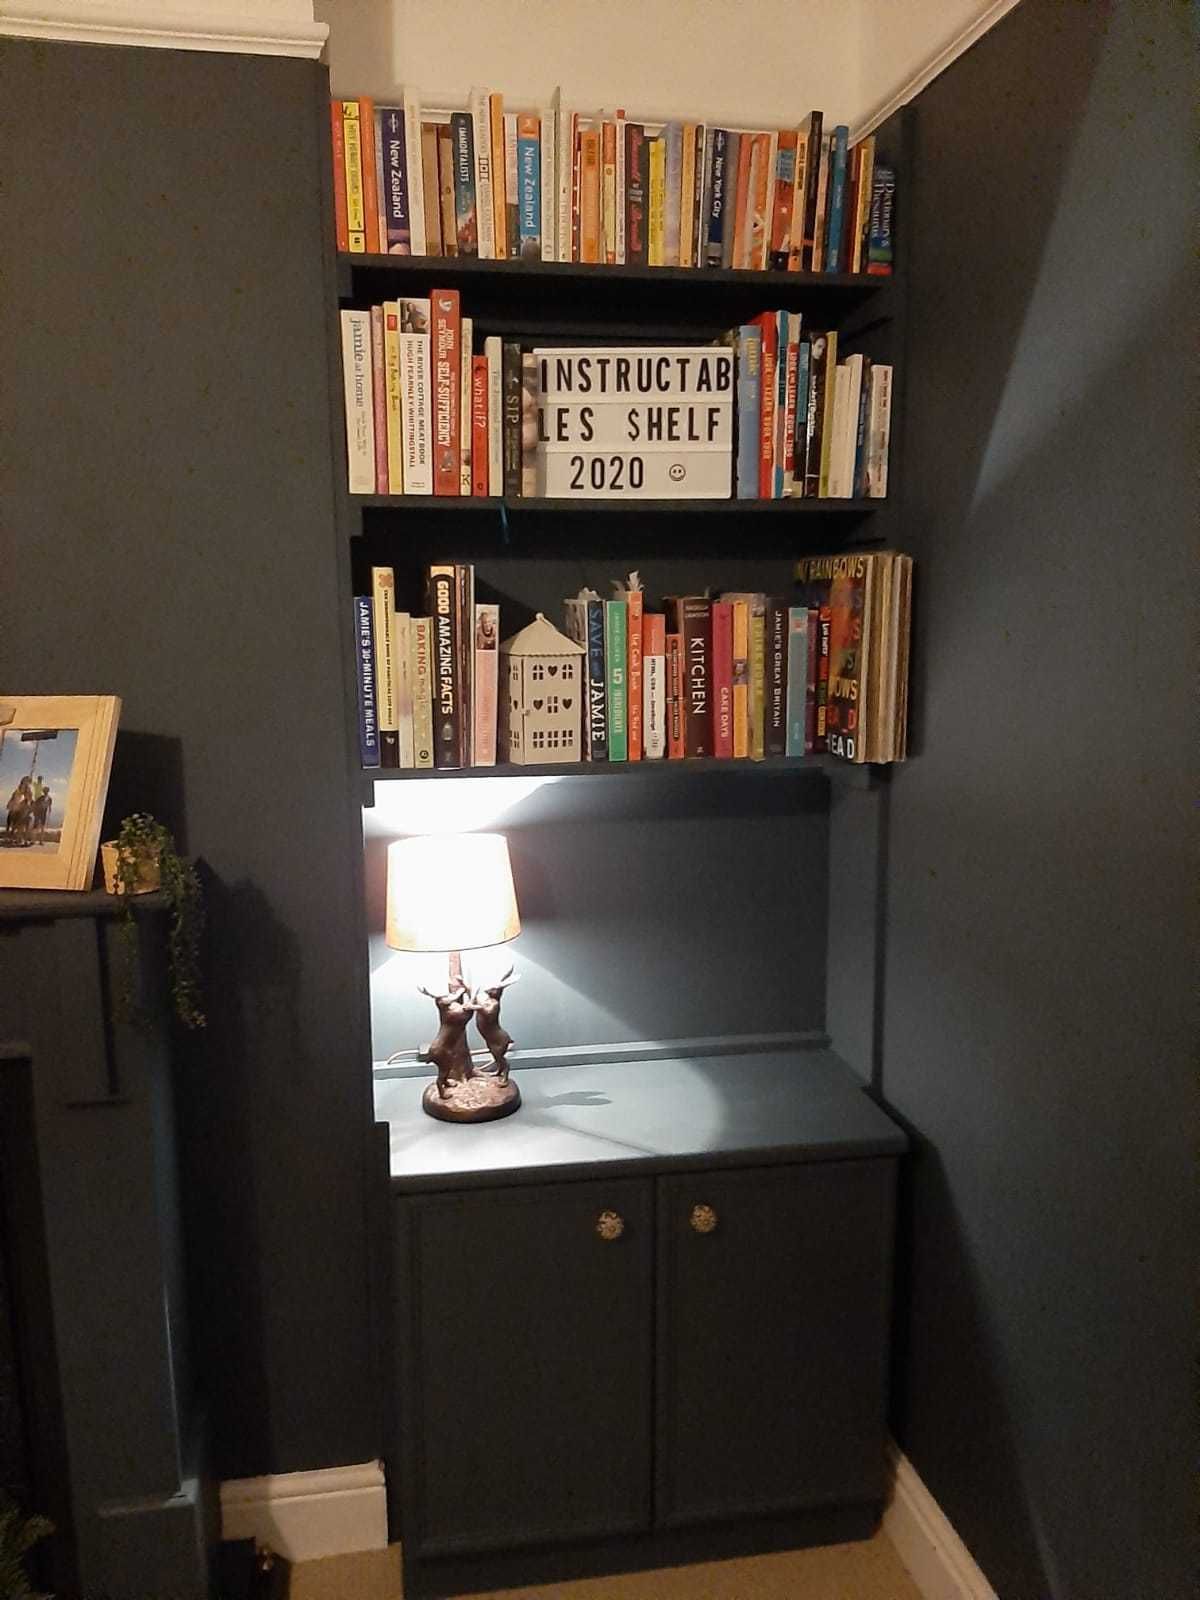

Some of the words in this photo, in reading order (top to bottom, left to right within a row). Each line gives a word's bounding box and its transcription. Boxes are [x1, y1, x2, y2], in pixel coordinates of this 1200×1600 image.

[390, 140, 402, 167] New
[524, 147, 535, 174] New
[714, 157, 724, 177] New
[392, 170, 405, 219] Zealand
[525, 178, 537, 228] Zealand
[713, 179, 723, 198] York
[711, 200, 722, 218] City
[351, 319, 366, 362] jamie
[406, 340, 414, 363] HUGH
[416, 340, 424, 354] THE
[416, 357, 424, 380] RIVER
[541, 357, 731, 393] INSTRUCTAB
[355, 374, 365, 407] home
[417, 382, 425, 417] COTTAGE
[474, 376, 486, 408] what
[475, 410, 487, 429] if?
[506, 395, 519, 423] SIP
[537, 407, 594, 441] LES
[418, 443, 426, 465] BOOK
[570, 456, 643, 490] 2020
[359, 601, 371, 647] JAMIE'S
[590, 608, 603, 656] SAVE
[774, 611, 783, 649] JAMIE'S
[417, 624, 426, 675] BAKING
[439, 616, 452, 675] AMAZING
[362, 649, 373, 706] 30-MINUTE
[690, 638, 706, 715] KITCHEN
[774, 652, 782, 684] GREAT
[440, 677, 453, 714] FACTS
[590, 679, 605, 741] JAMIE
[720, 687, 729, 711] CAKE
[773, 688, 782, 727] BRITAIN
[364, 708, 375, 746] MEALS
[720, 714, 729, 738] DAYS
